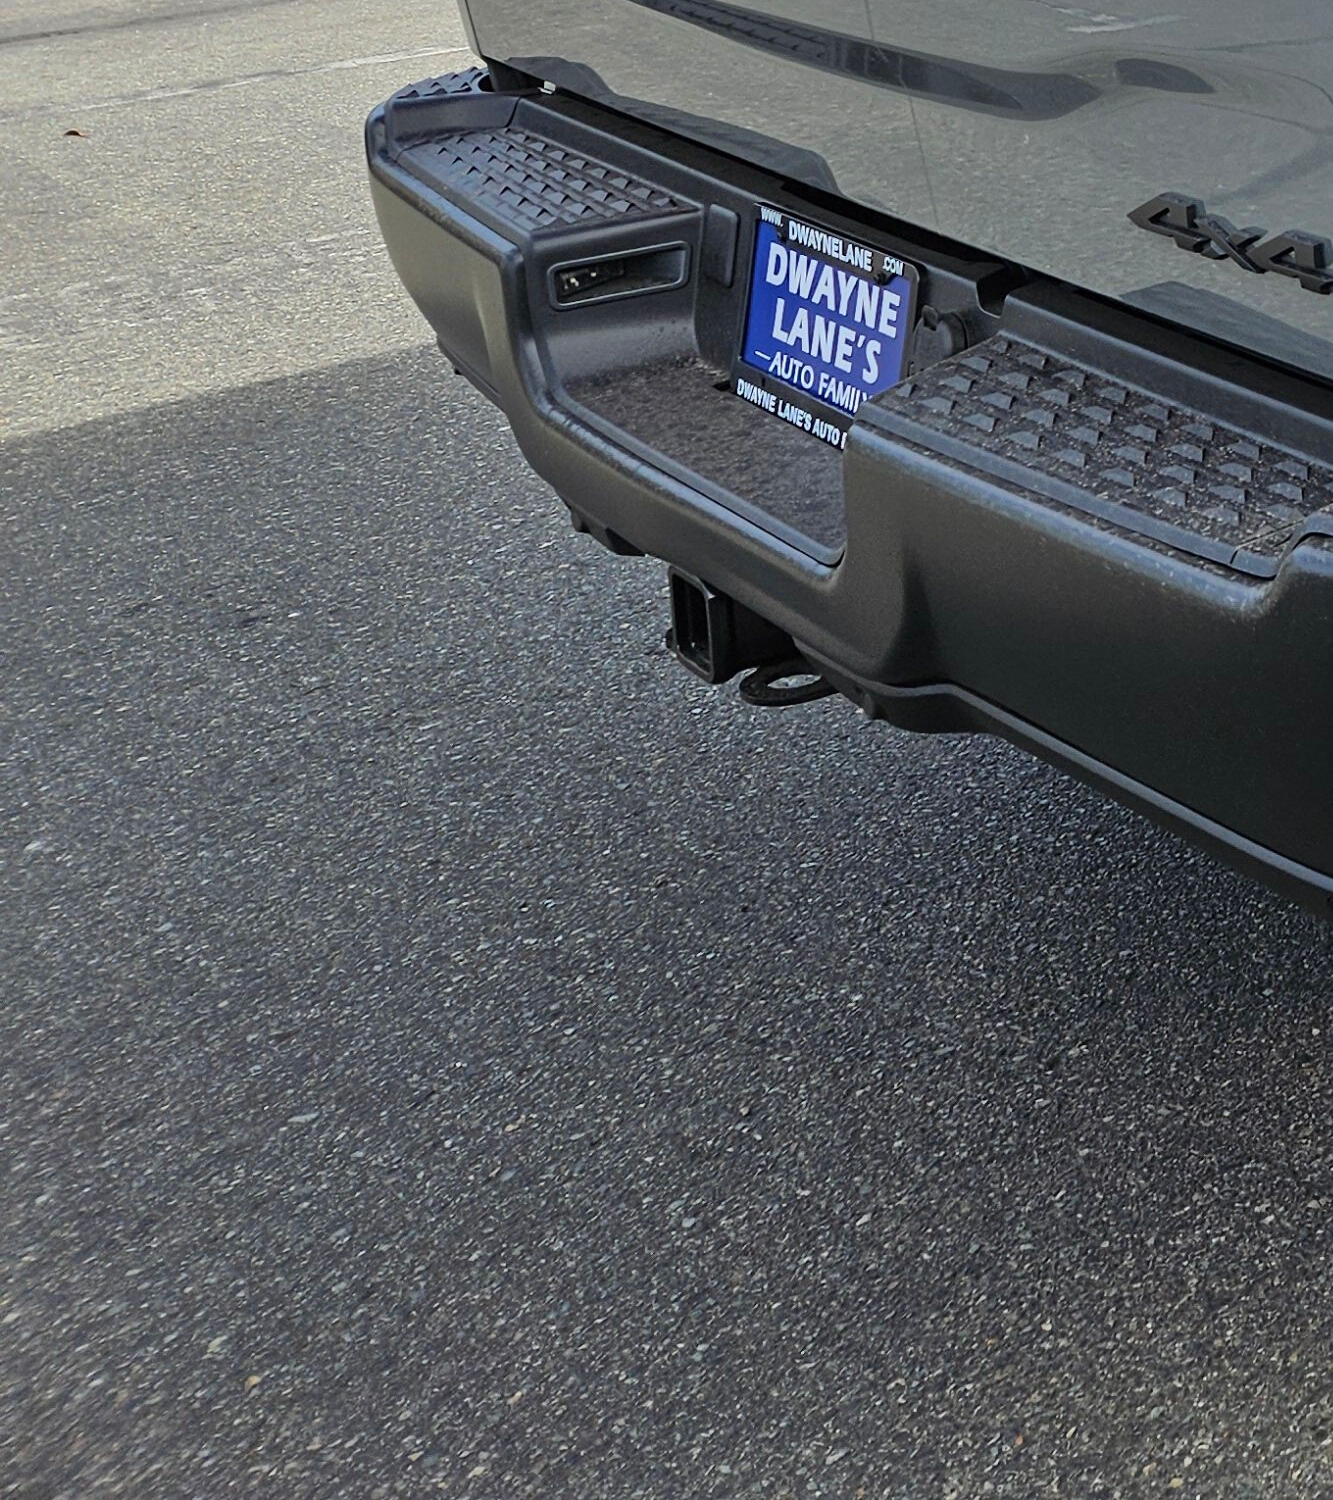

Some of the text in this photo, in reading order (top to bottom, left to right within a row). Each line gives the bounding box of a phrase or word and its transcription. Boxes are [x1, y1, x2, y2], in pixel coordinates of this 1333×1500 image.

[788, 220, 873, 272] DWAYNELANE
[765, 241, 901, 339] DWAYNE
[768, 351, 815, 389] AUTO
[772, 297, 882, 385] LANE'S
[736, 378, 776, 414] DWAYNE
[777, 399, 812, 432] LANE'S
[812, 418, 840, 446] AUTO
